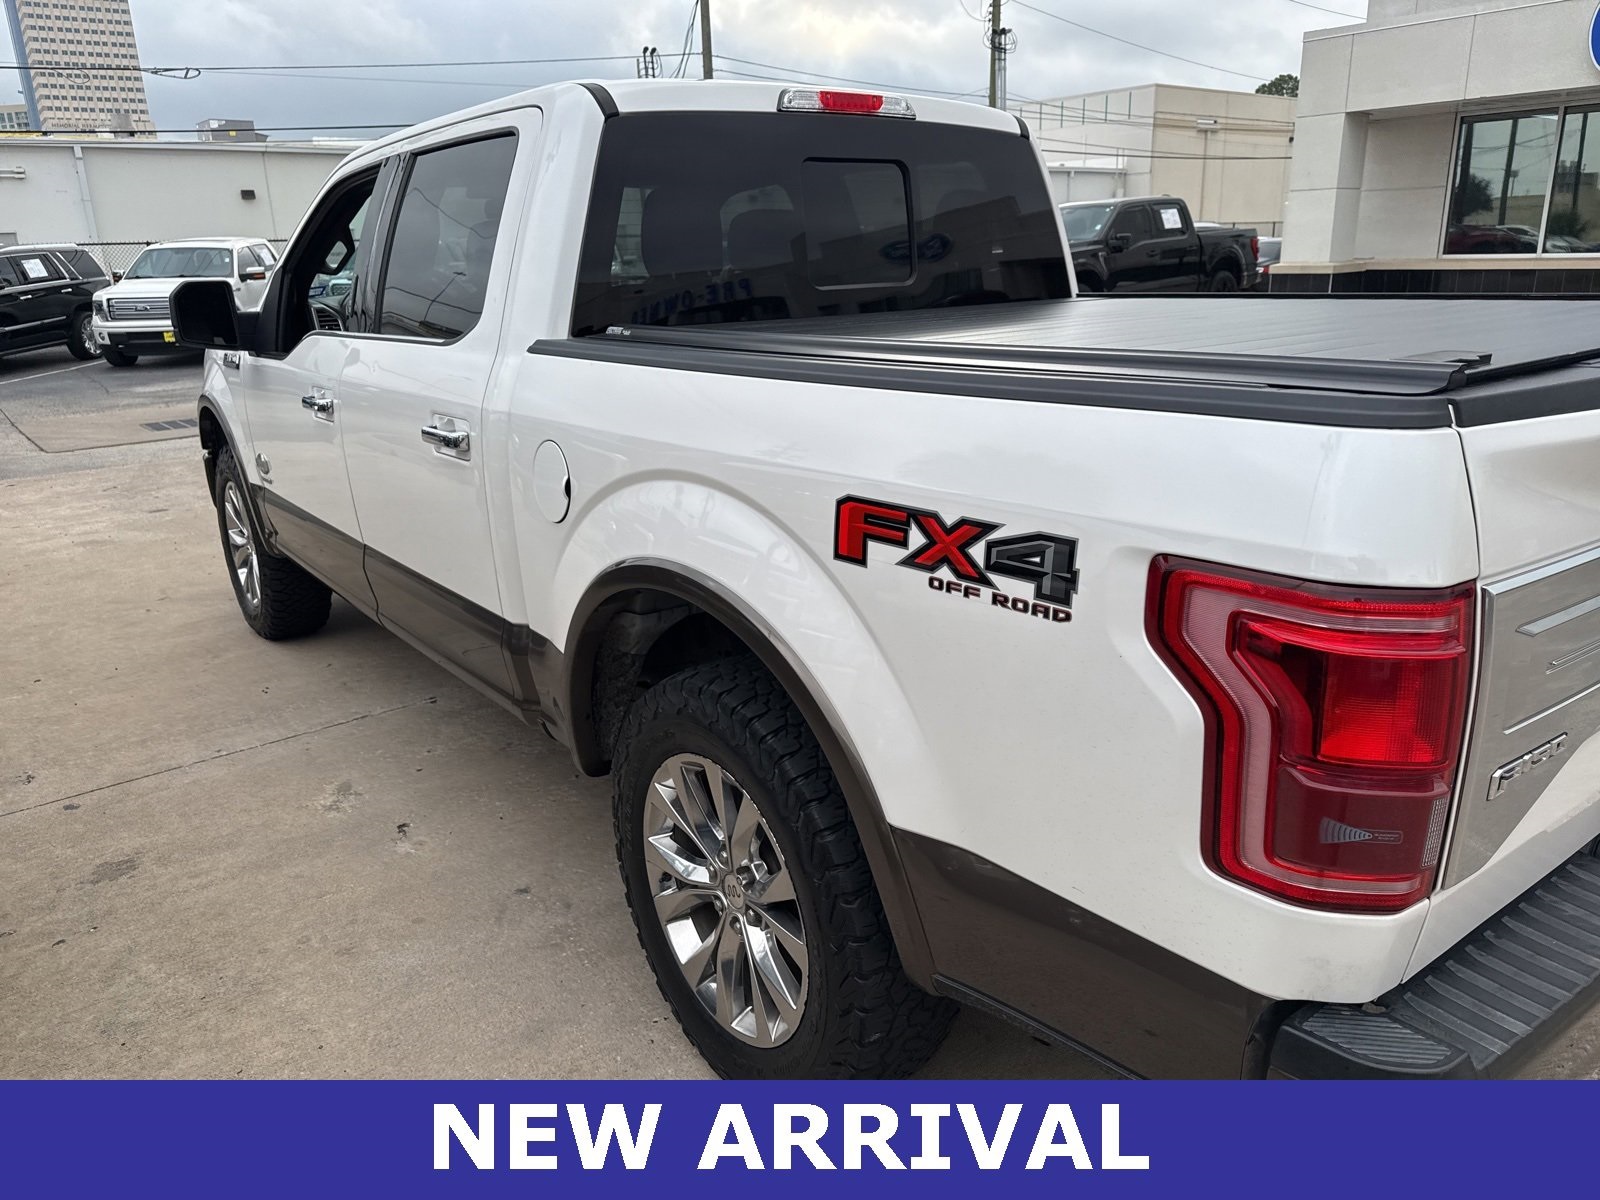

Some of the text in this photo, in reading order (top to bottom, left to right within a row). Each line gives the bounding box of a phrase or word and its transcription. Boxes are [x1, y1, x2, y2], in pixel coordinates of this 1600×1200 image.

[833, 493, 1080, 609] FX4
[928, 575, 1073, 623] OFF ROAD
